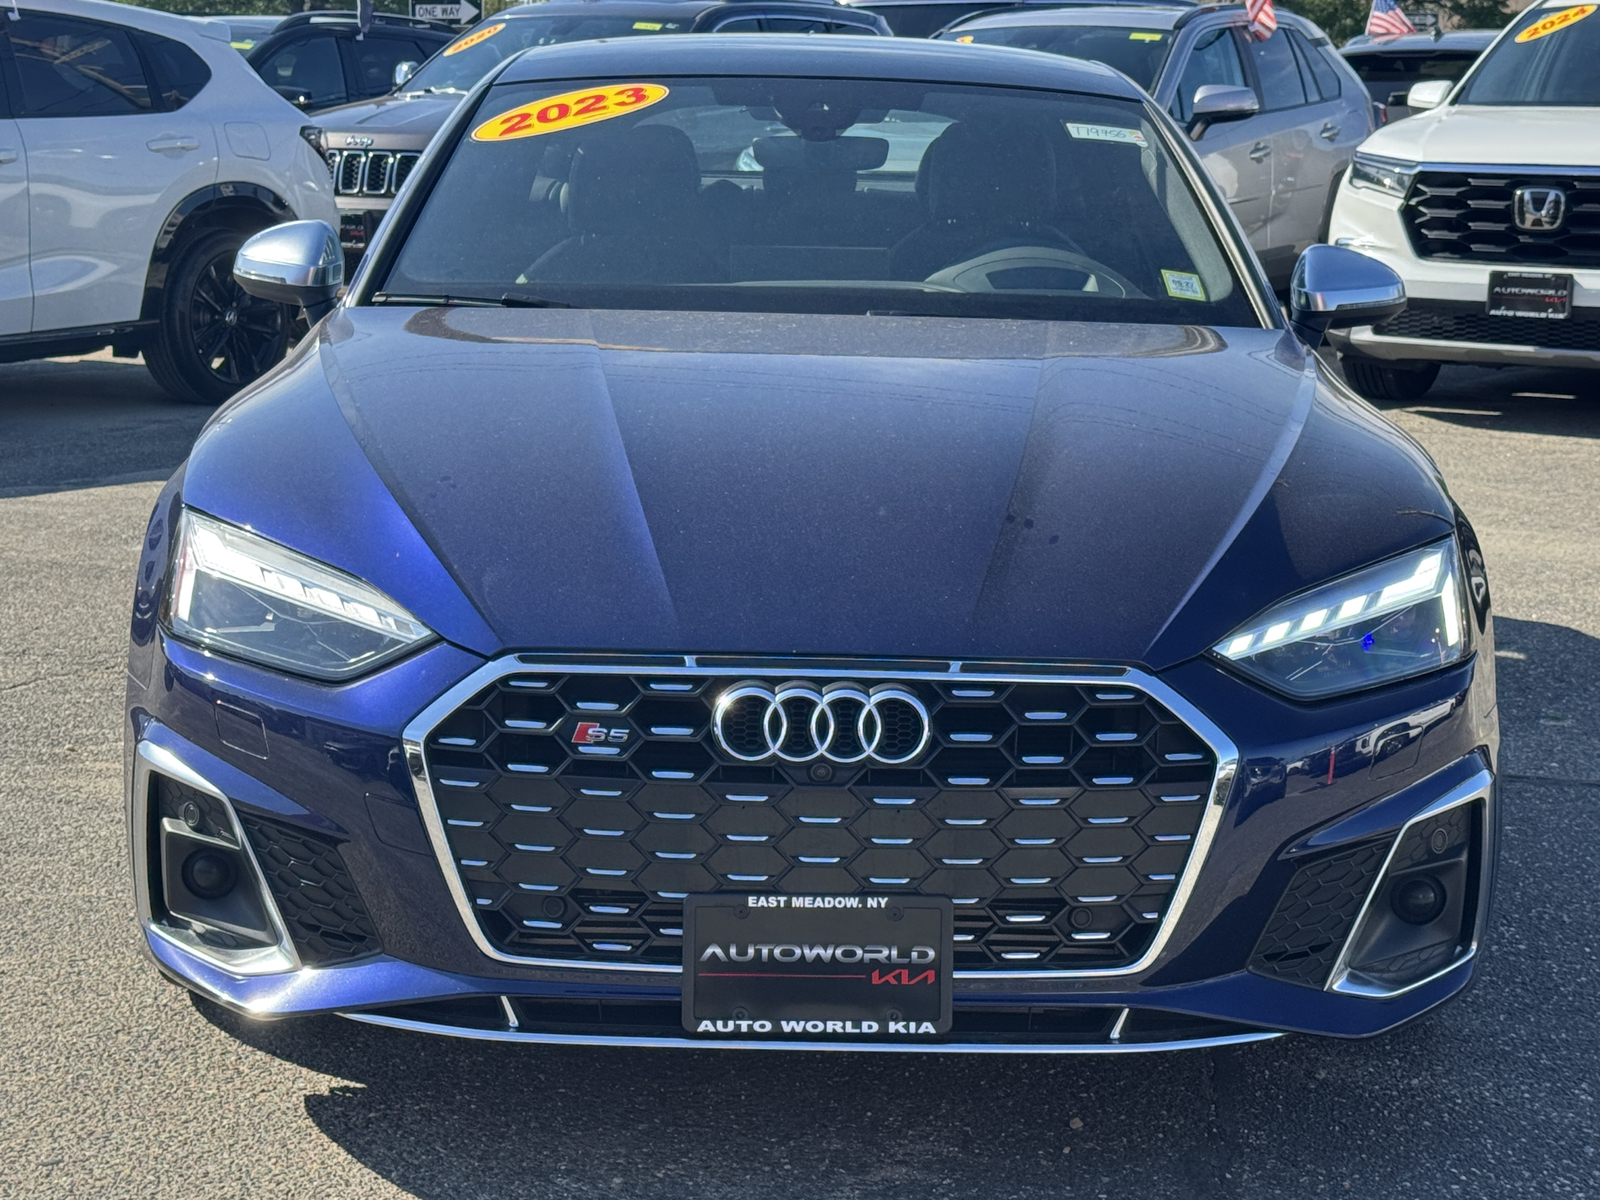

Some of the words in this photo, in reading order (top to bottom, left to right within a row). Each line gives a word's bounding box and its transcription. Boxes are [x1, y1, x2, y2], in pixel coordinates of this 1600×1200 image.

[418, 6, 437, 18] ONE
[441, 6, 460, 17] WAY
[1525, 6, 1588, 38] 2024
[498, 87, 650, 137] 2023
[1489, 309, 1515, 317] AUTO
[586, 727, 630, 743] S5
[748, 896, 787, 908] EAST
[867, 897, 889, 908] NY
[700, 943, 936, 964] AUTOWORLD
[871, 969, 936, 985] KIA
[697, 1020, 772, 1033] AUTO
[780, 1020, 879, 1033] WORLD
[888, 1021, 937, 1034] KIA
